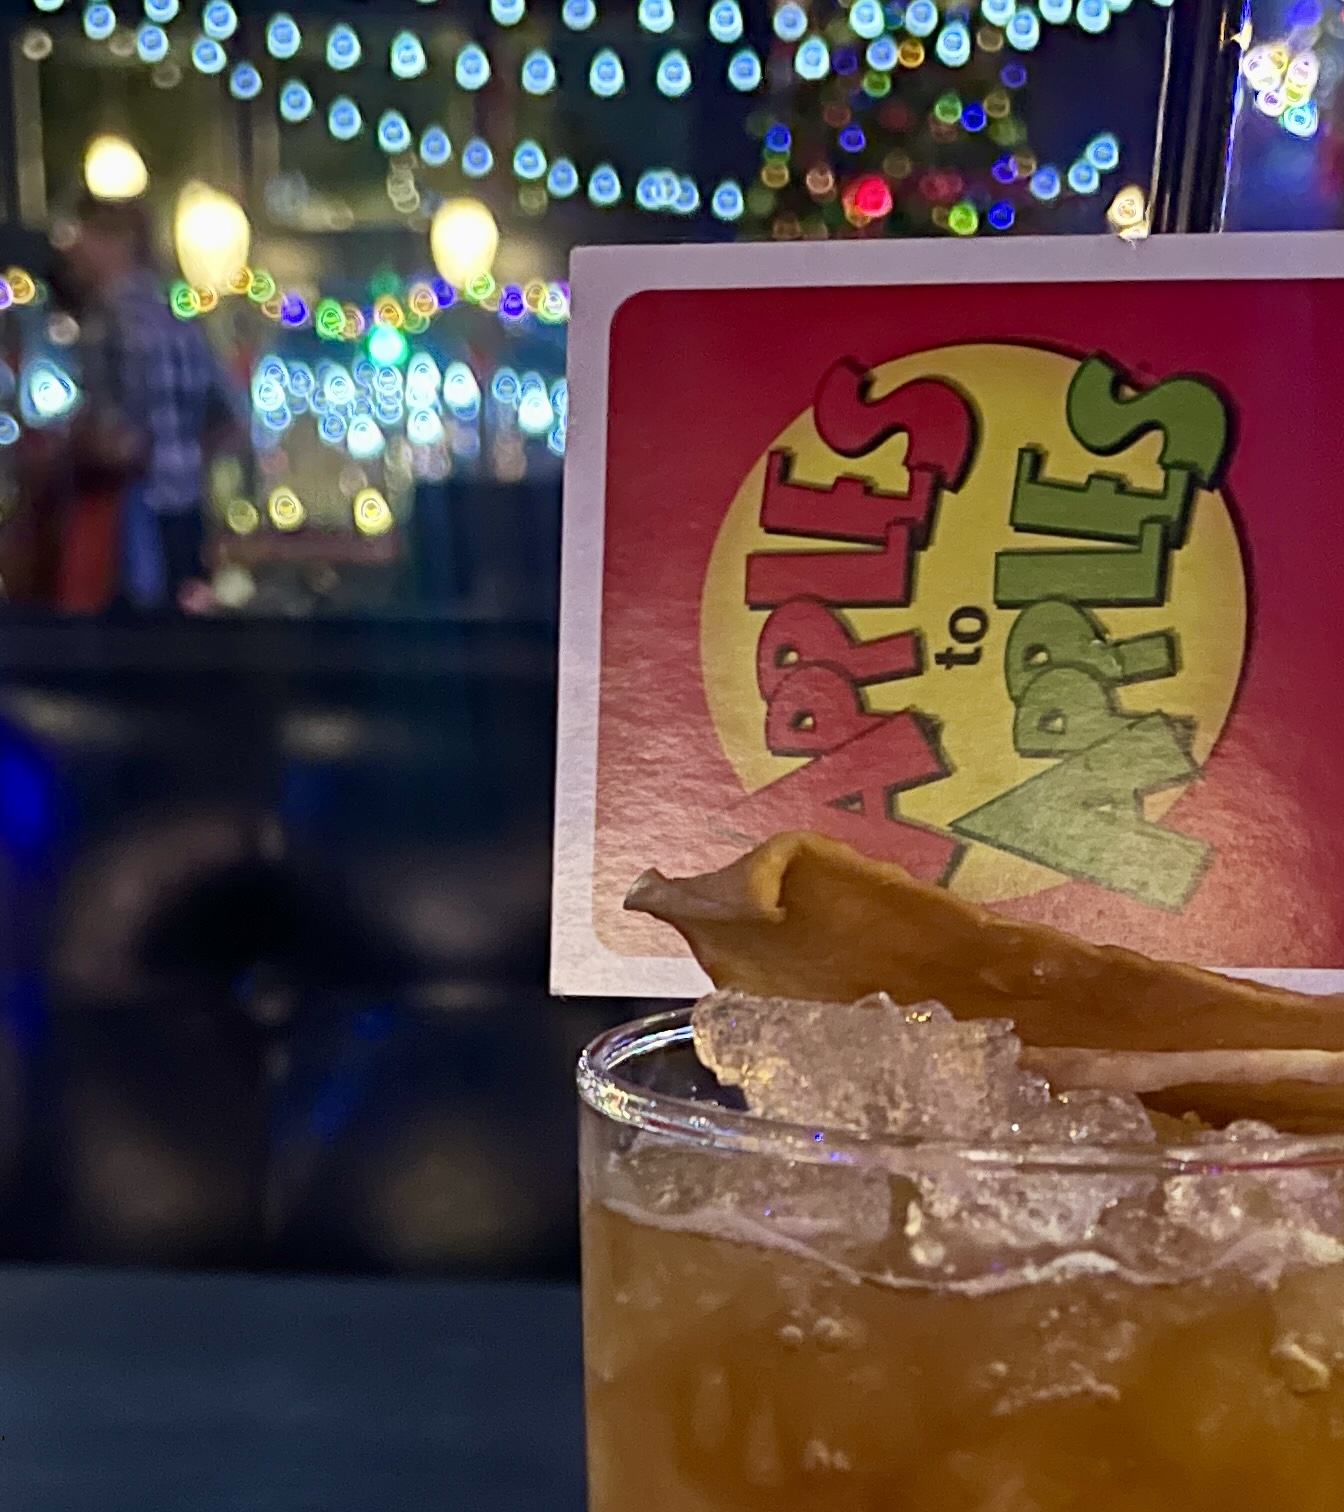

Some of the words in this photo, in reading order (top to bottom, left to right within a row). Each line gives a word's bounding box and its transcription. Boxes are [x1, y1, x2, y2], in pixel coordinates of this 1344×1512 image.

[711, 356, 981, 888] APPLES
[934, 602, 990, 669] to
[949, 352, 1239, 912] APPLES
